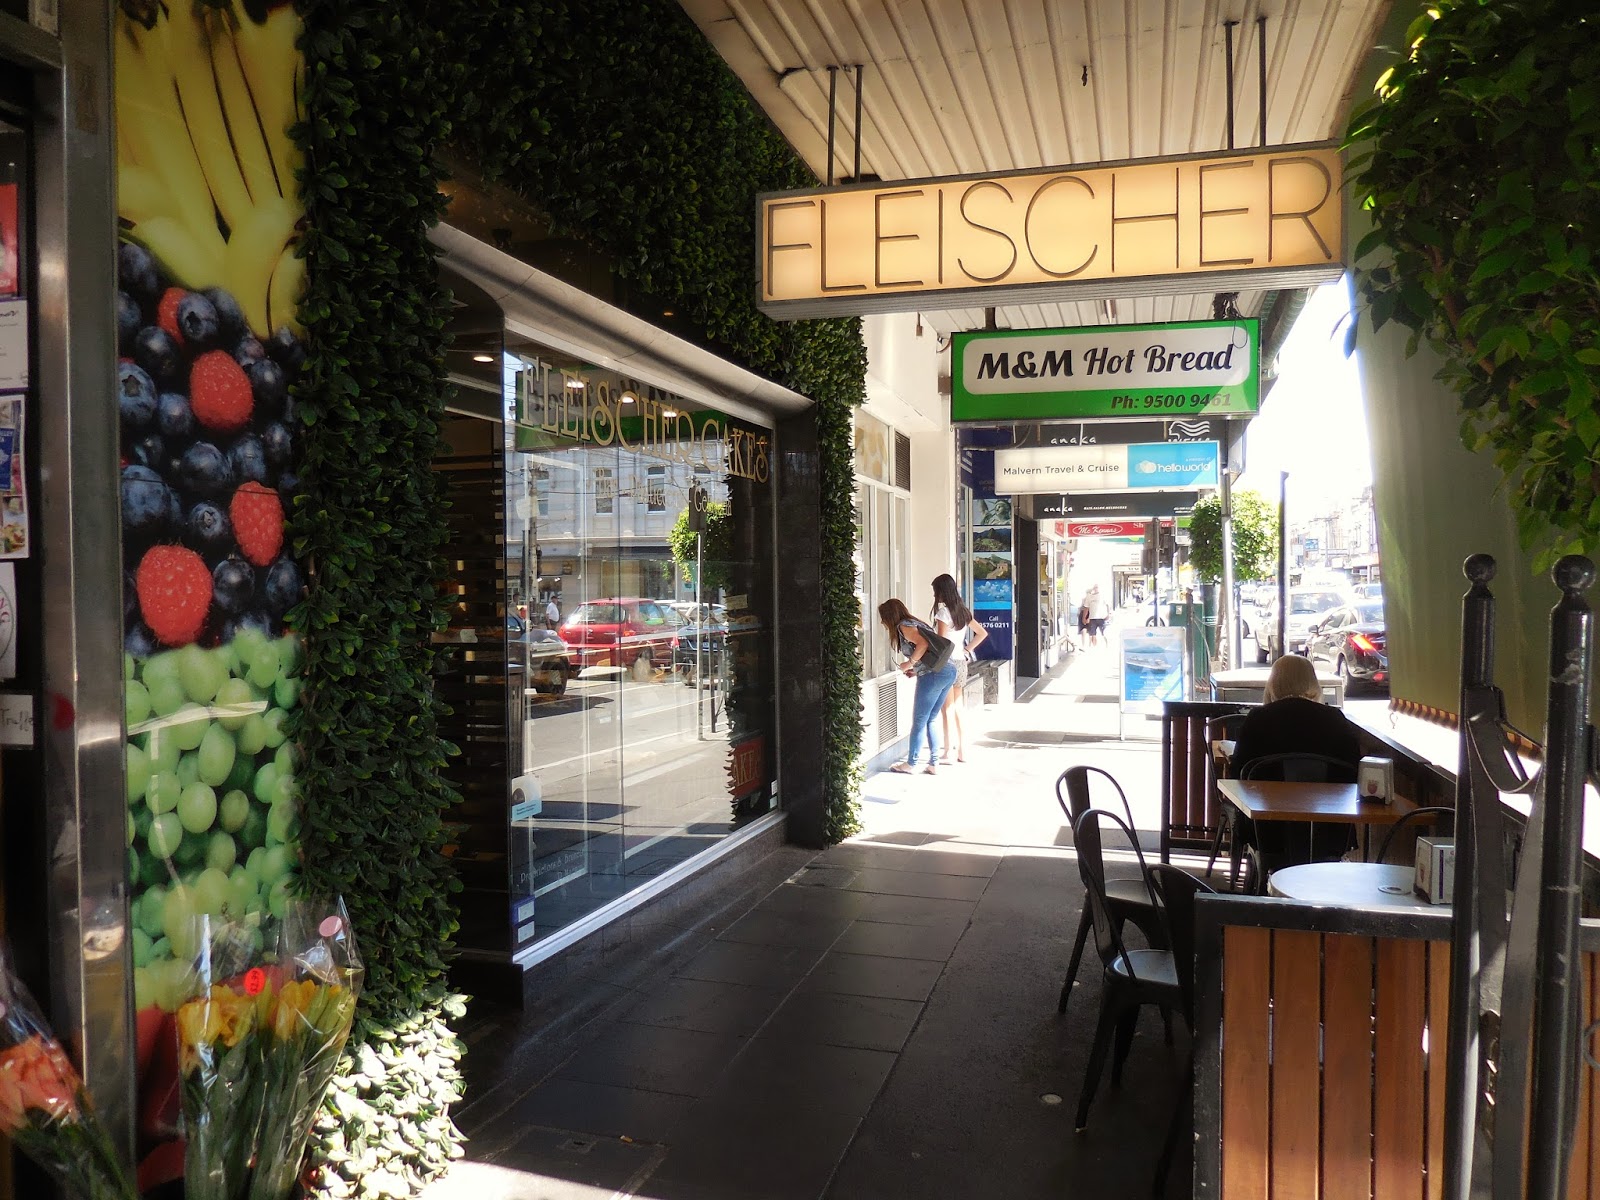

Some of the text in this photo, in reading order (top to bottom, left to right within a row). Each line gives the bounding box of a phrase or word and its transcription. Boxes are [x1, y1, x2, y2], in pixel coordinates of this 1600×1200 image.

[767, 155, 1334, 297] FLEISCHER
[976, 344, 1235, 380] M&M Hot Bread
[1111, 393, 1232, 409] Ph: 9500 9461
[519, 354, 769, 483] FLEISCHER CAKES
[1050, 423, 1097, 446] anaka
[1003, 463, 1120, 475] Malvern Travel & Cruise
[1158, 462, 1211, 473] helloworld
[1043, 497, 1073, 516] anaka
